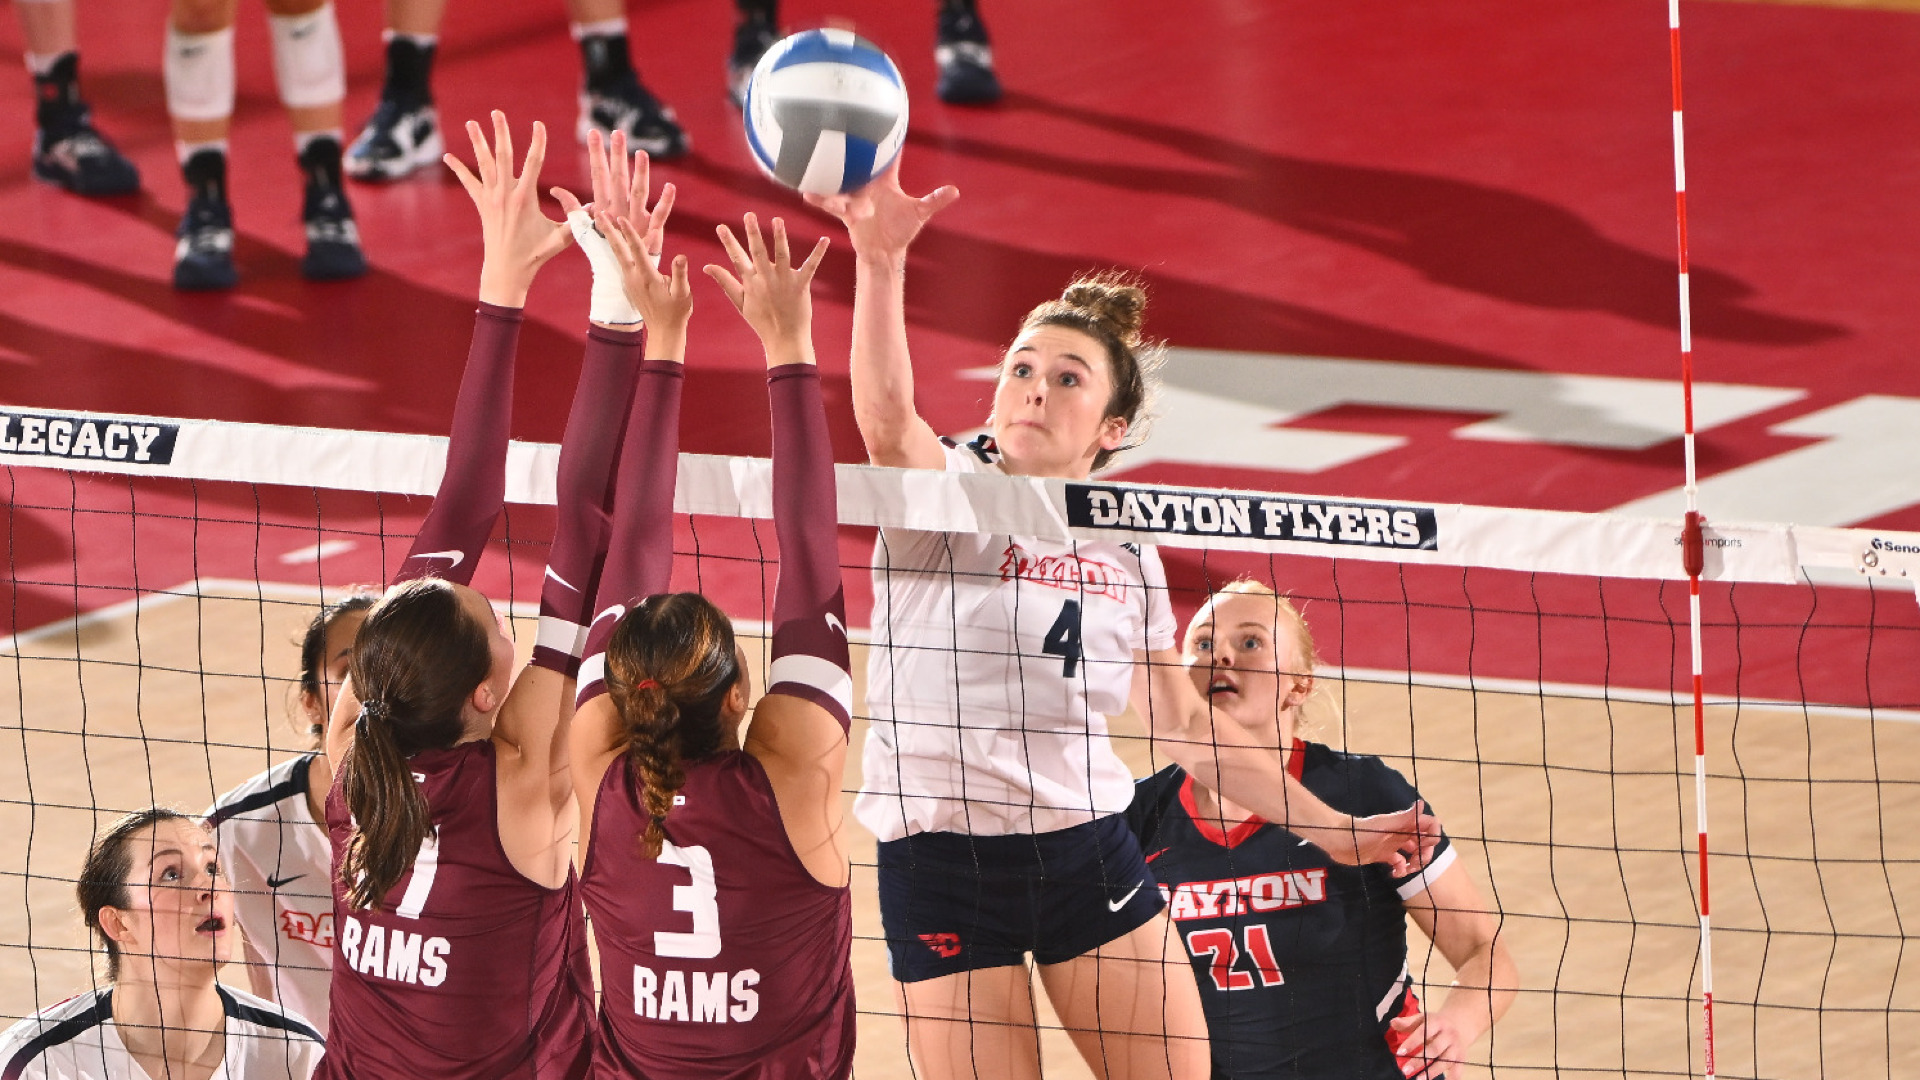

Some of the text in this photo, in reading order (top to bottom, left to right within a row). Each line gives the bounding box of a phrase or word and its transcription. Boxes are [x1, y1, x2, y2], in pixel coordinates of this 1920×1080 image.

[0, 416, 160, 461] LEGACY
[1087, 490, 1421, 545] DAYTON FLYERS
[1042, 599, 1081, 678] 4
[654, 838, 722, 959] 3
[342, 914, 451, 987] RAMS
[1187, 924, 1285, 991] 21
[633, 964, 761, 1023] RAMS
